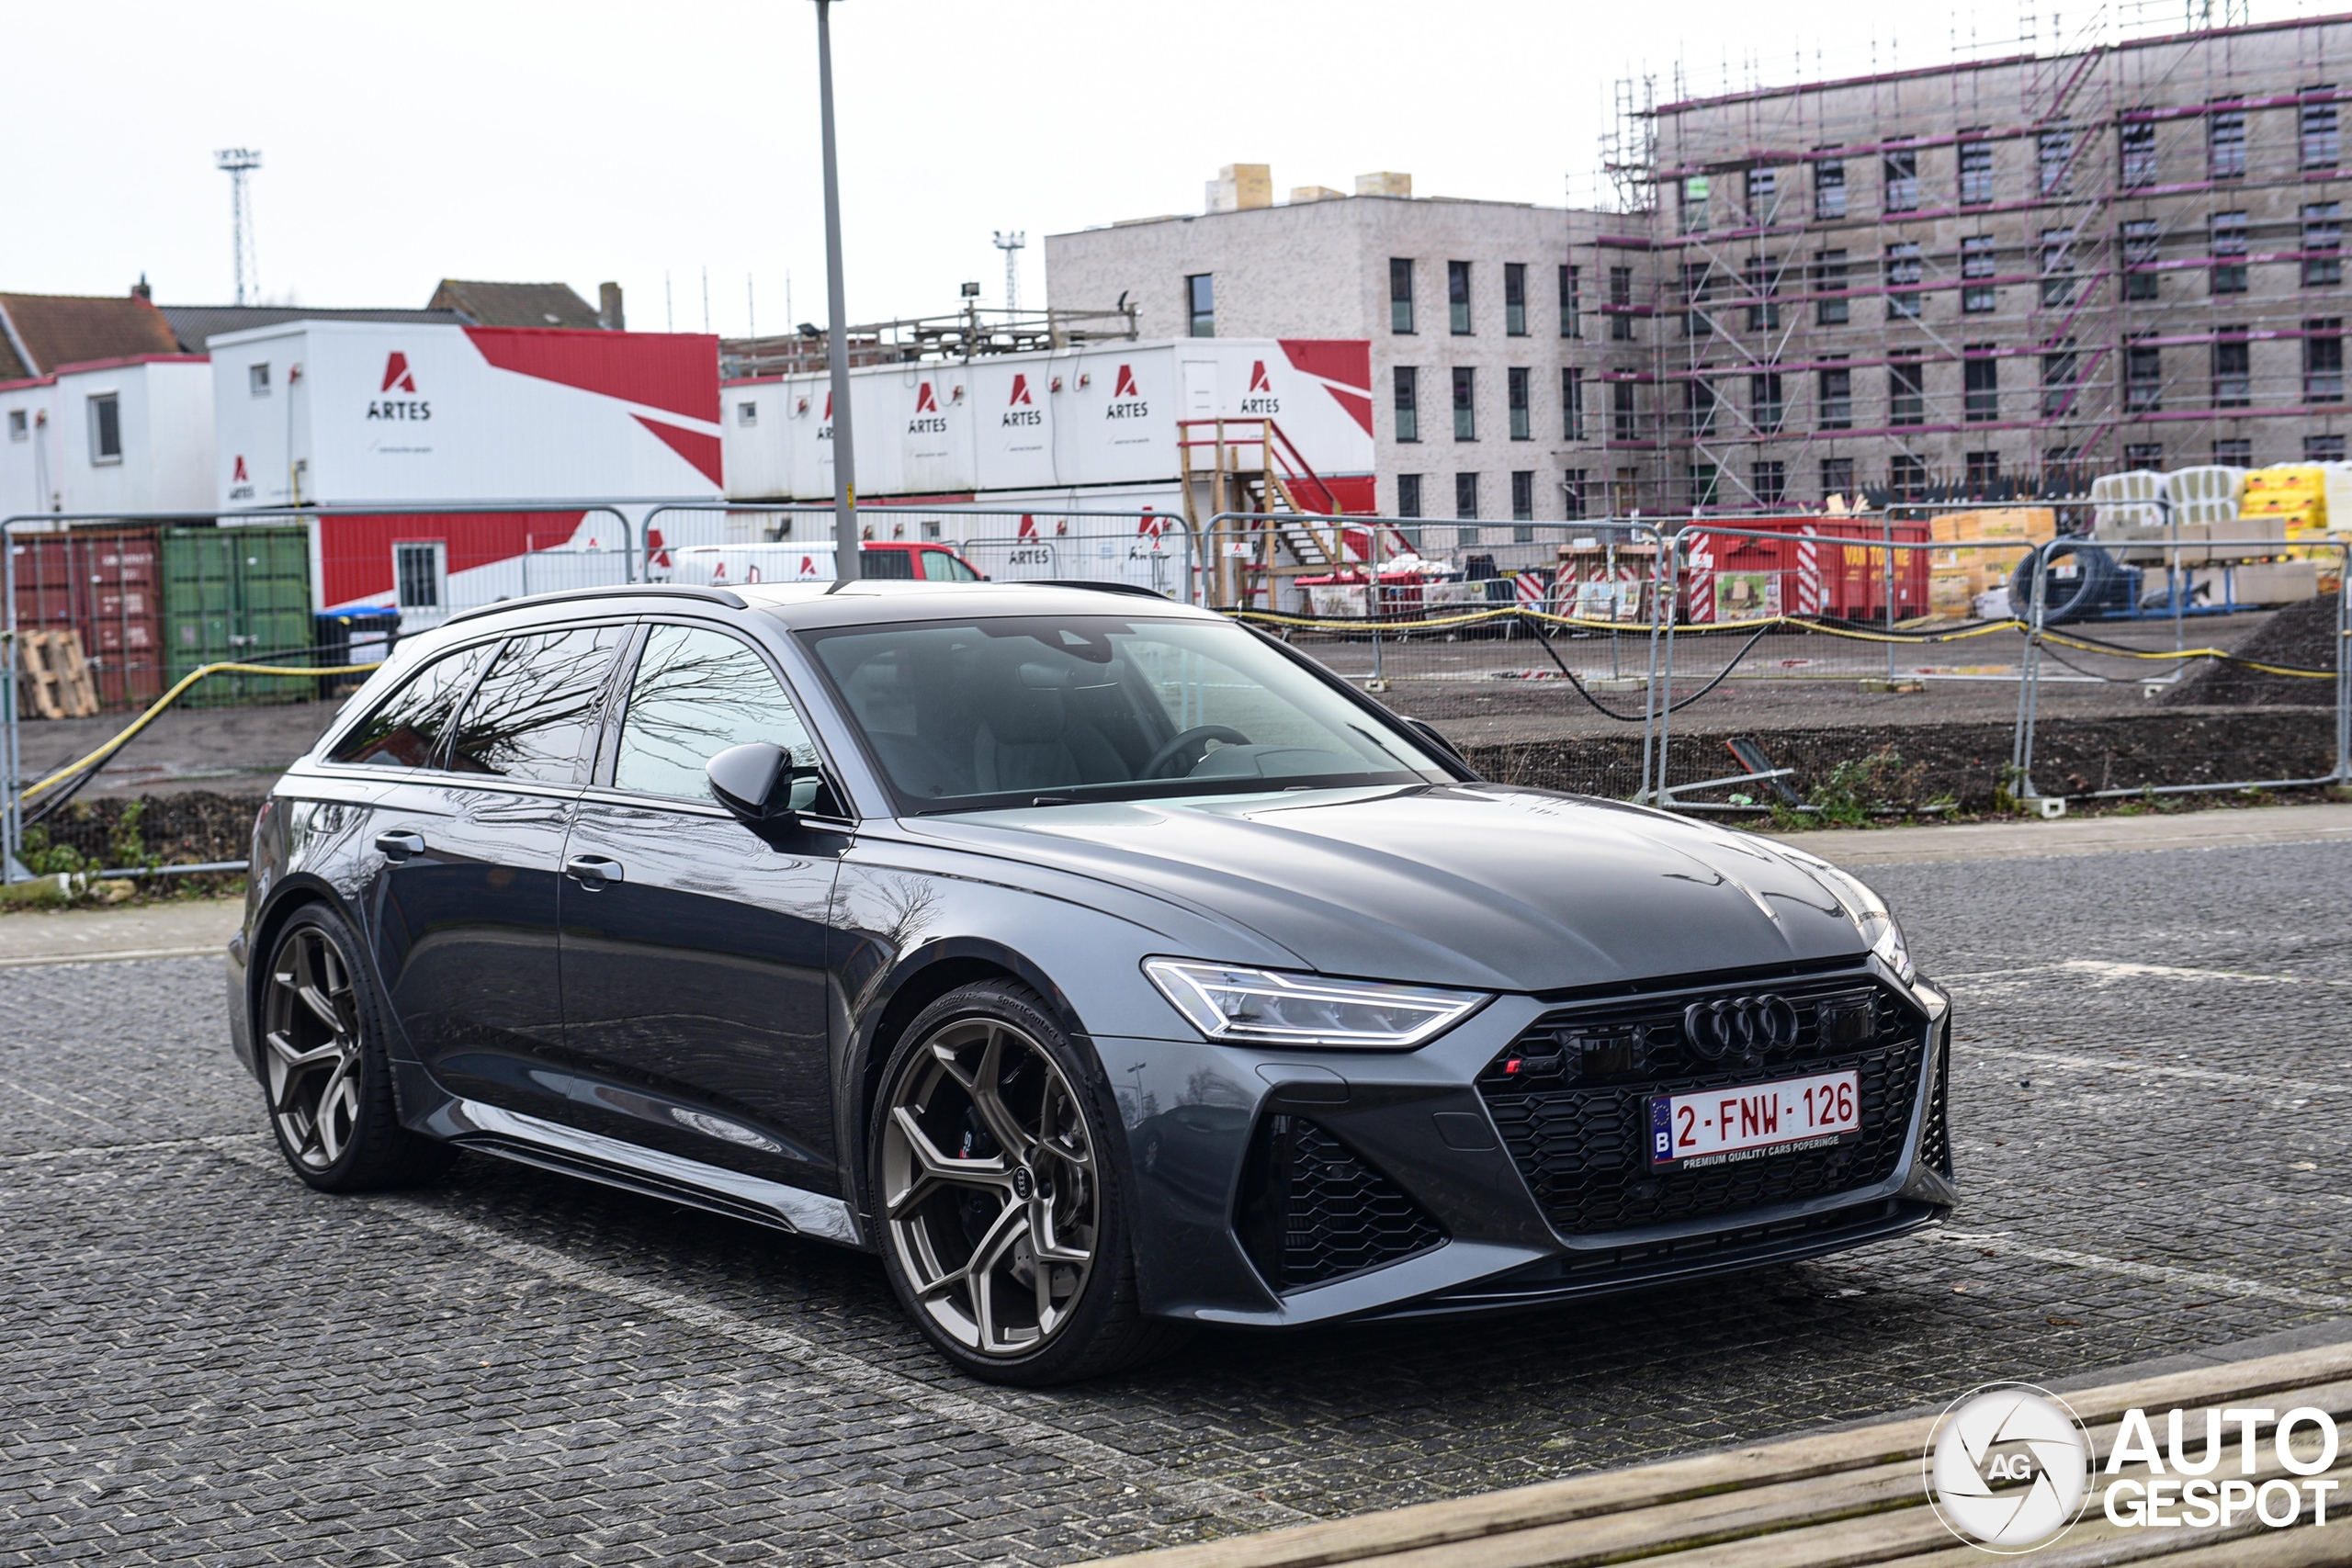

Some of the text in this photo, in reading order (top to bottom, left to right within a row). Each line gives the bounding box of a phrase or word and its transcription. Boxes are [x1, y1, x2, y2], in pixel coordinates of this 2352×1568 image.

[367, 400, 431, 421] ARTES
[1105, 401, 1148, 420] ARTES
[1240, 399, 1280, 413] ARTES
[908, 417, 946, 434] ARTES
[1001, 410, 1041, 427] ARTES
[1009, 549, 1049, 566] ARTES
[1843, 545, 1867, 566] VAN
[997, 995, 1059, 1041] SportContact
[1656, 1133, 1669, 1153] B
[1683, 1134, 1840, 1169] PREMIUM QUALITY CARS POPERINGE
